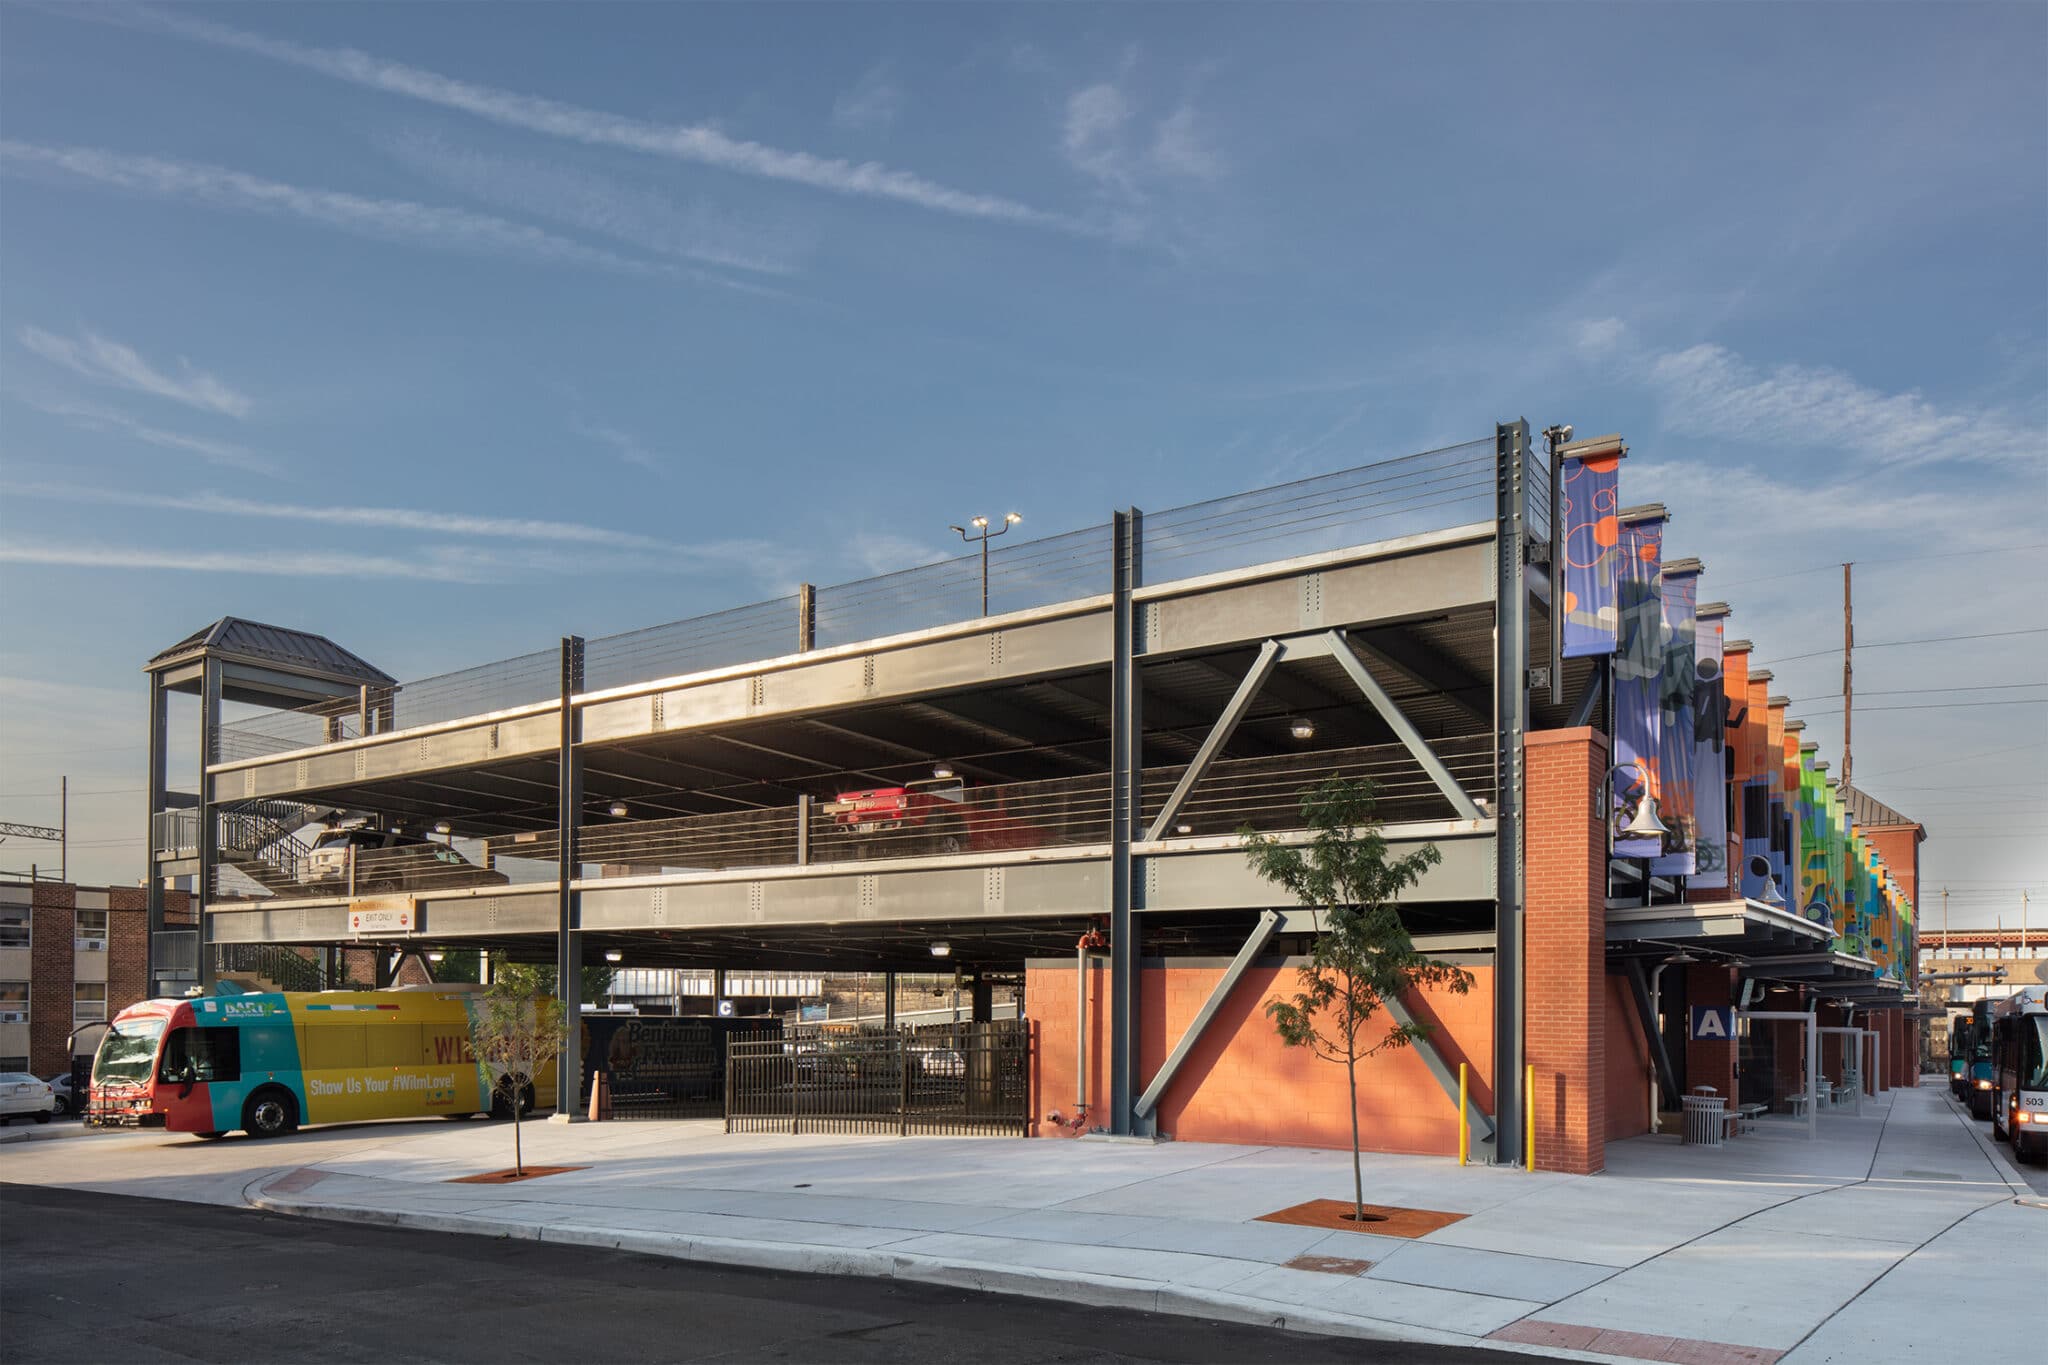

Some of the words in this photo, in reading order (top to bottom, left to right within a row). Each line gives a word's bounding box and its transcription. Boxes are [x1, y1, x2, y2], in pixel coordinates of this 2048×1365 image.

[365, 912, 379, 922] EXIT
[379, 911, 393, 921] ONLY
[225, 1001, 265, 1014] DART
[719, 1001, 732, 1016] C
[1697, 1009, 1726, 1037] A
[627, 1021, 713, 1045] Benjamin
[640, 1045, 717, 1066] Franklin
[310, 1079, 343, 1096] Show
[347, 1076, 361, 1094] Us
[364, 1076, 389, 1093] Your
[392, 1072, 455, 1092] #WilmLove!
[2025, 1097, 2044, 1106] 503
